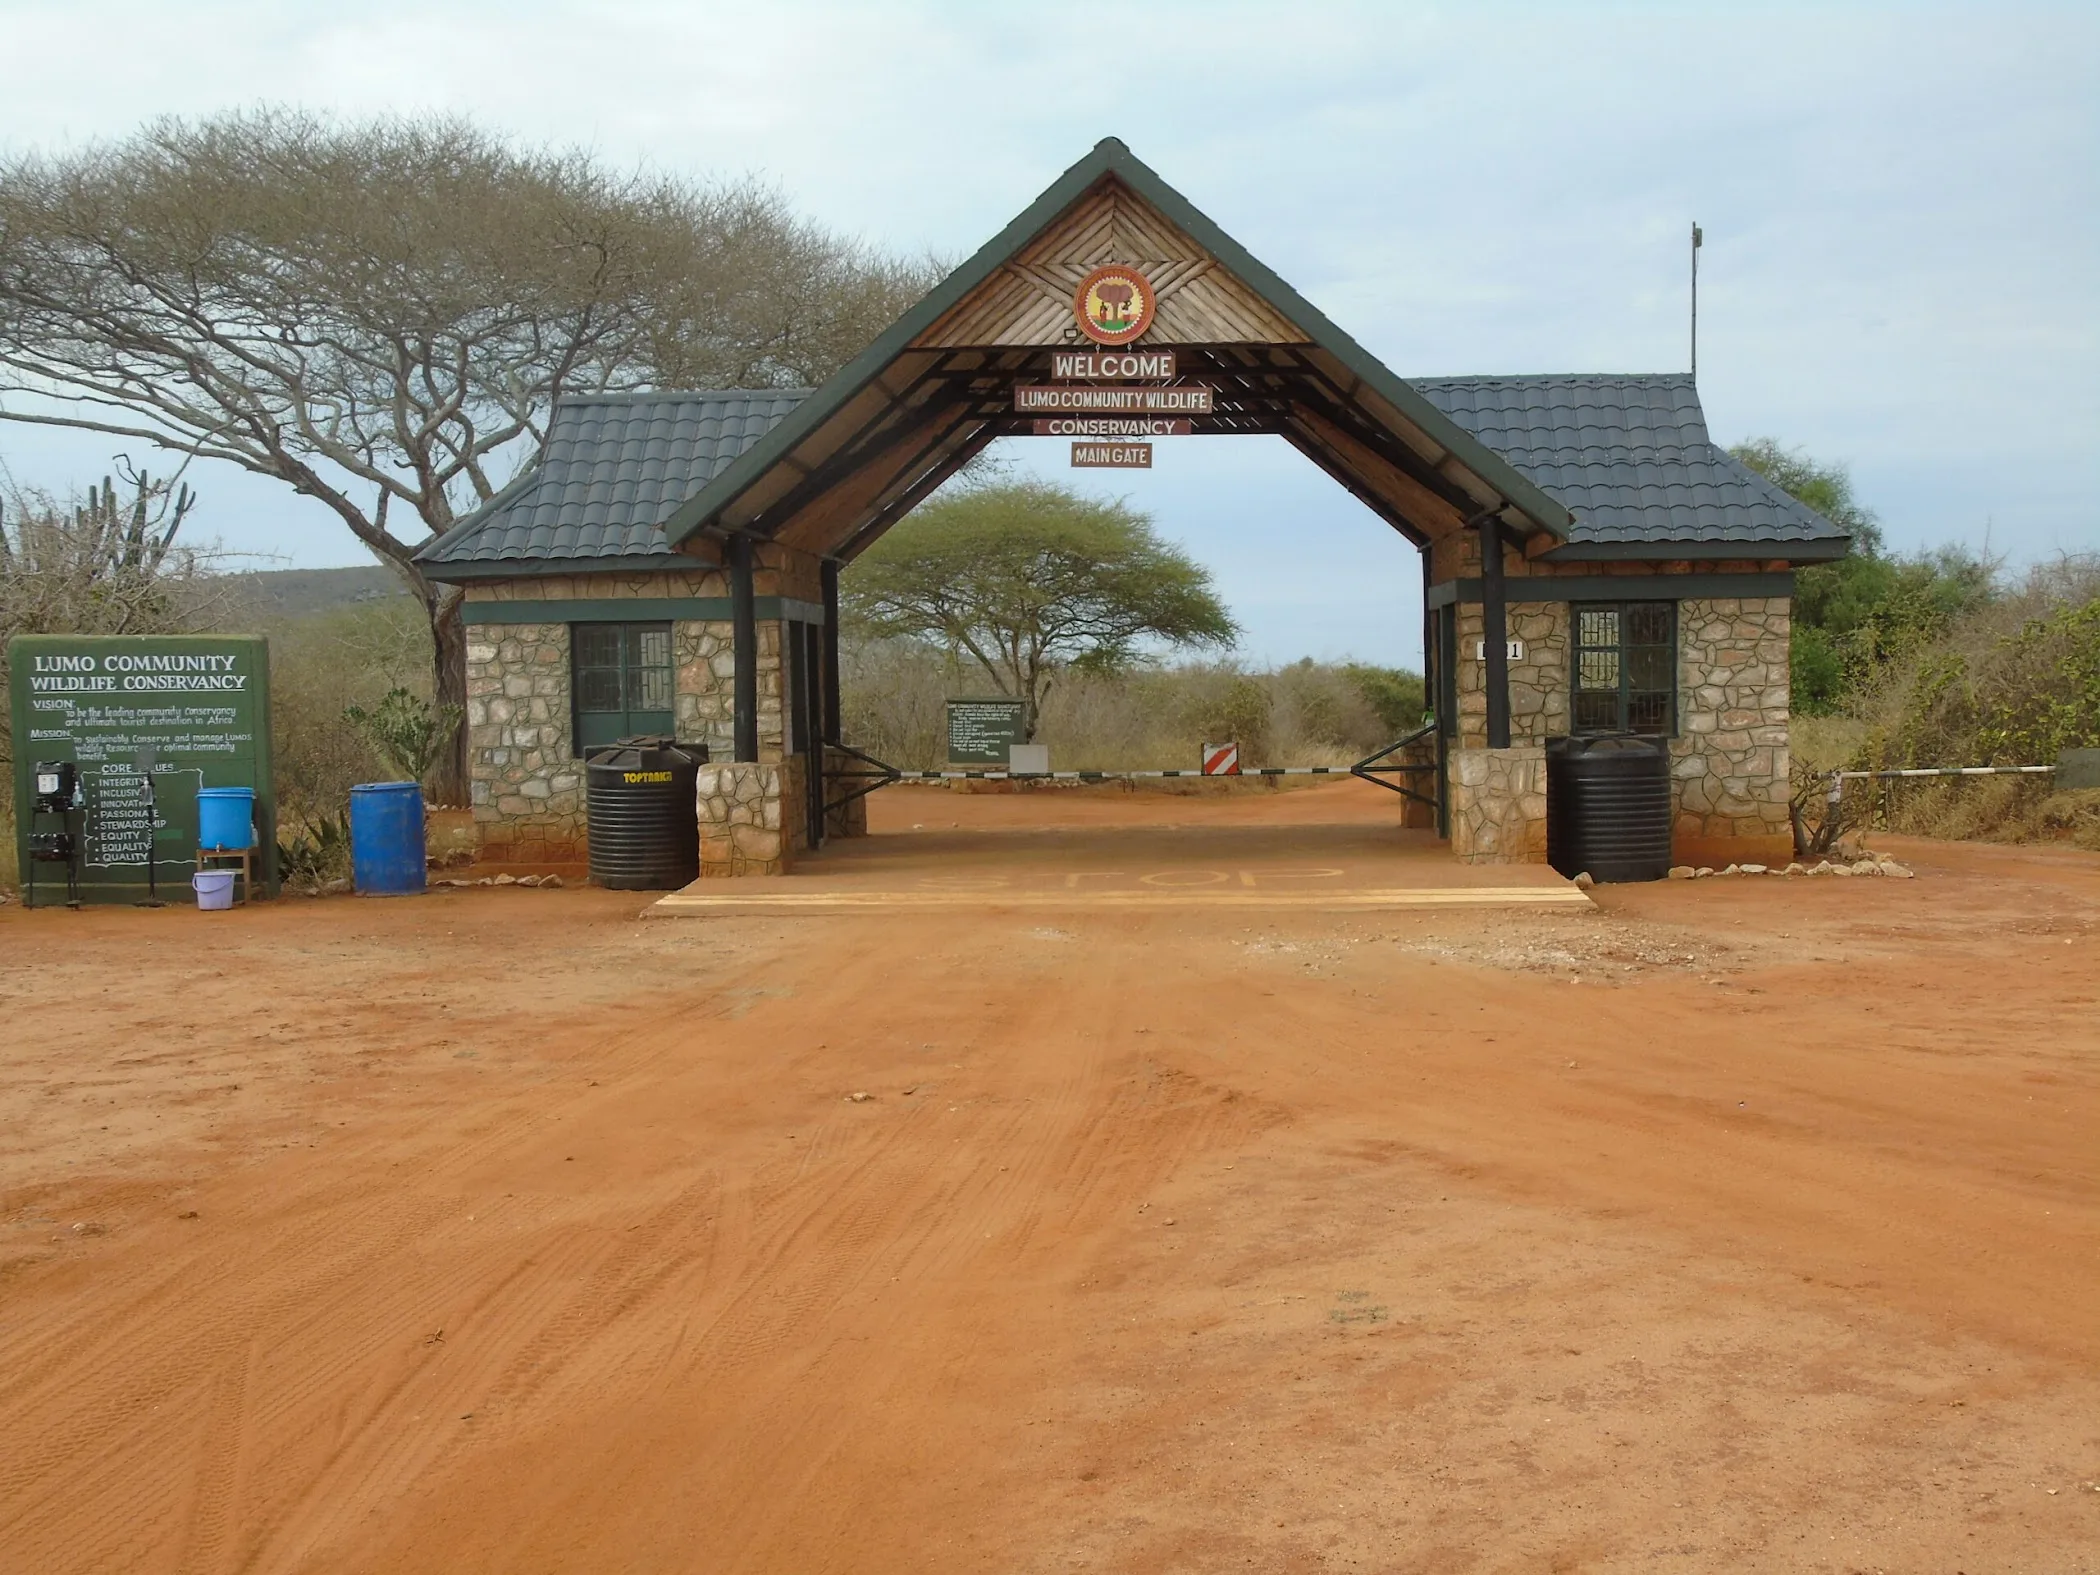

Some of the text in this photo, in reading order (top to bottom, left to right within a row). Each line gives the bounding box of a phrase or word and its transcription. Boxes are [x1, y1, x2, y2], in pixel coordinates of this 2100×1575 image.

[1056, 356, 1172, 377] WELCOME
[1021, 391, 1207, 409] LUMO COMMUNITY WILDLIFE
[1048, 420, 1176, 435] CONSERVANCY
[1075, 447, 1148, 464] MAIN GATE
[34, 655, 236, 672] LUMO COMMUNITY
[30, 675, 247, 691] WILDLIFE CONSERVANCY
[77, 707, 87, 717] be
[88, 706, 101, 717] the
[105, 706, 135, 719] leading
[137, 705, 180, 718] community
[65, 718, 81, 727] and
[84, 717, 116, 727] ultimate
[120, 717, 146, 726] tourist
[150, 716, 192, 726] destination
[195, 717, 204, 725] in
[85, 734, 129, 744] sustainably
[175, 733, 190, 742] and
[192, 734, 224, 743] manage
[163, 743, 191, 753] optimal
[101, 764, 132, 773] CORE
[100, 831, 140, 841] EQUITY
[101, 842, 149, 852] EQUALITY
[102, 853, 148, 862] QUALITY
